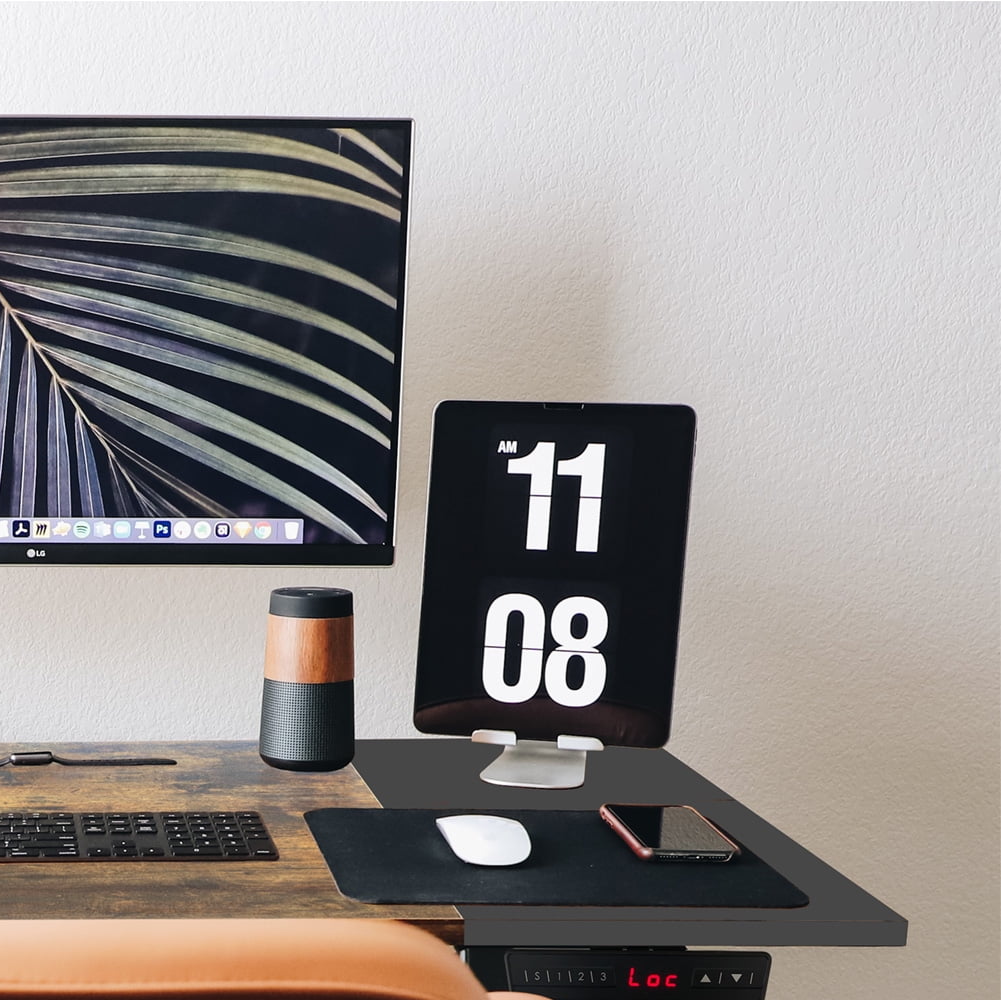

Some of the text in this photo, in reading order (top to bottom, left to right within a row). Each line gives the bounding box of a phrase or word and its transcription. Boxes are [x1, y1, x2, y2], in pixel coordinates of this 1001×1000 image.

[497, 440, 518, 454] AM
[507, 441, 606, 553] 11
[156, 524, 169, 535] Ps
[482, 593, 609, 707] 08
[534, 971, 541, 981] S
[578, 972, 585, 981] 2
[600, 972, 607, 981] 3
